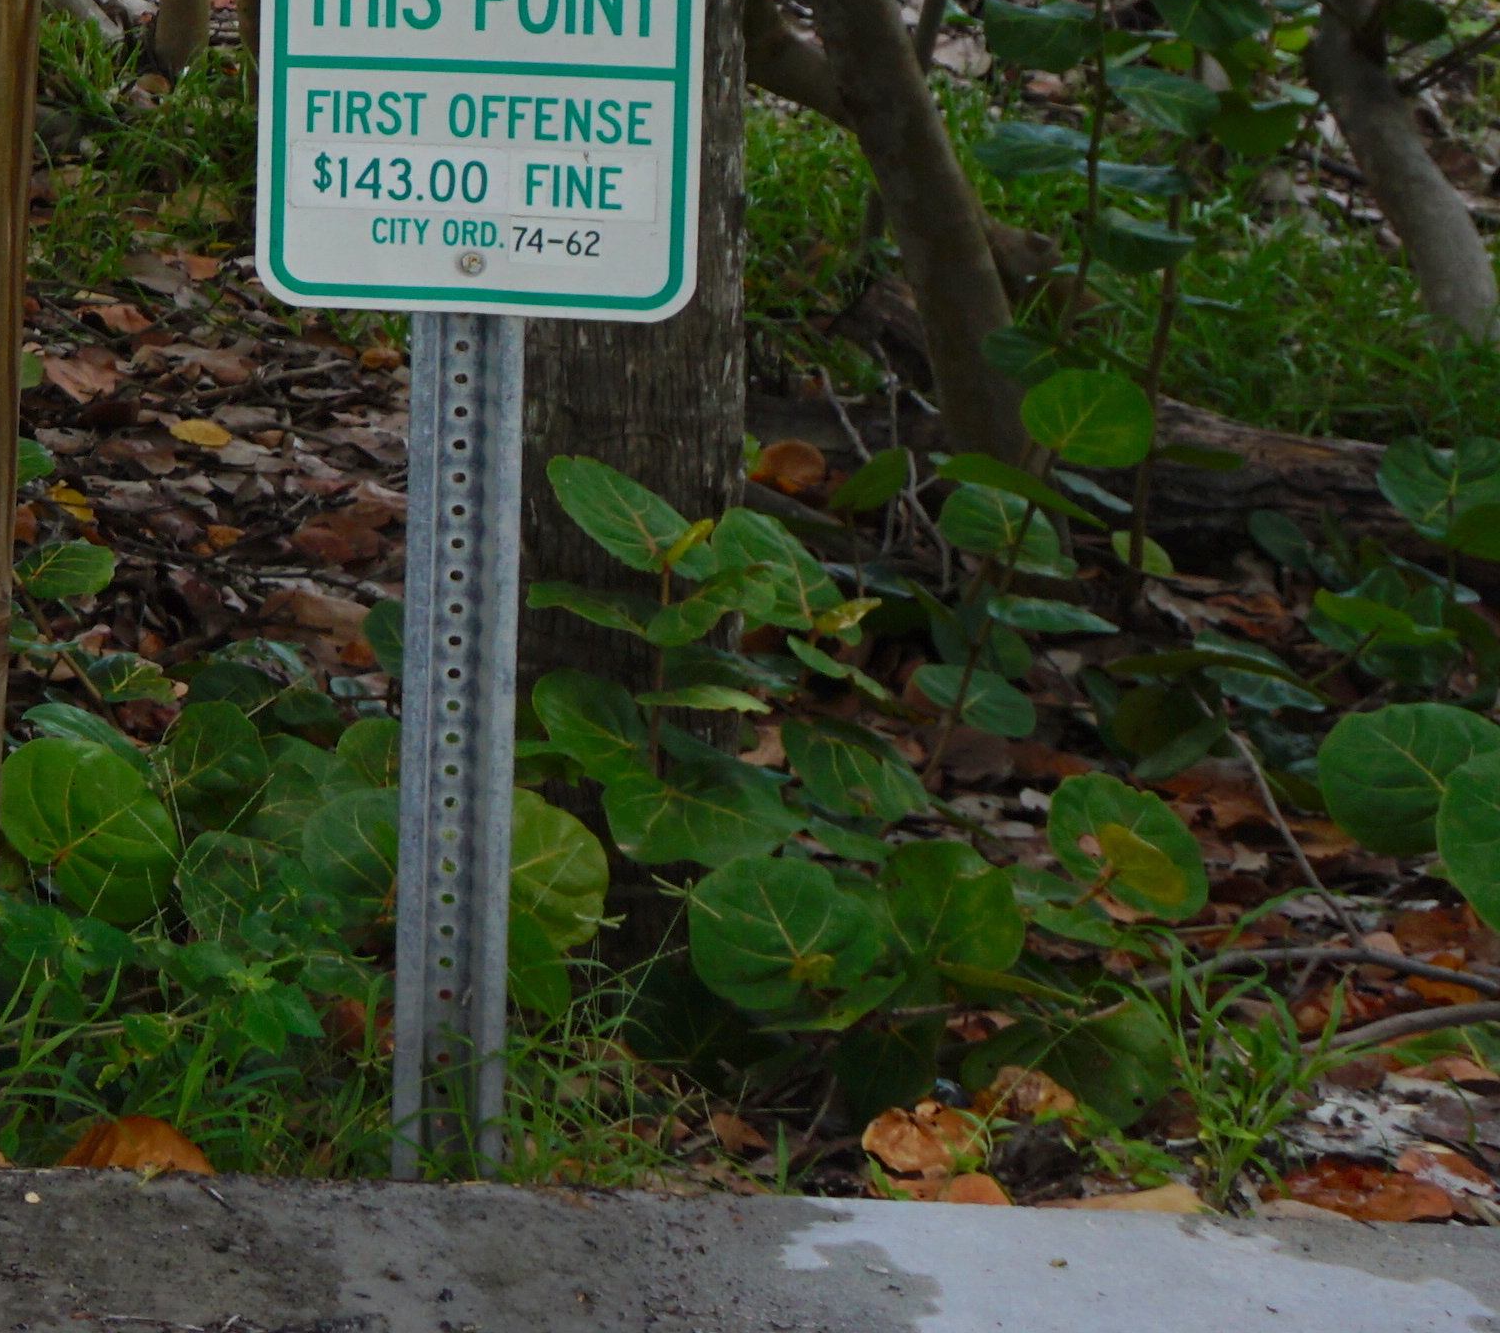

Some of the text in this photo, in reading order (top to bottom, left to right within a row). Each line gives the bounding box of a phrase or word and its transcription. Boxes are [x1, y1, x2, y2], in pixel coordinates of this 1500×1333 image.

[304, 89, 653, 145] FIRST OFFENSE
[312, 151, 624, 210] $143.00 FINE
[371, 217, 601, 257] CITY ORD. 74-62
